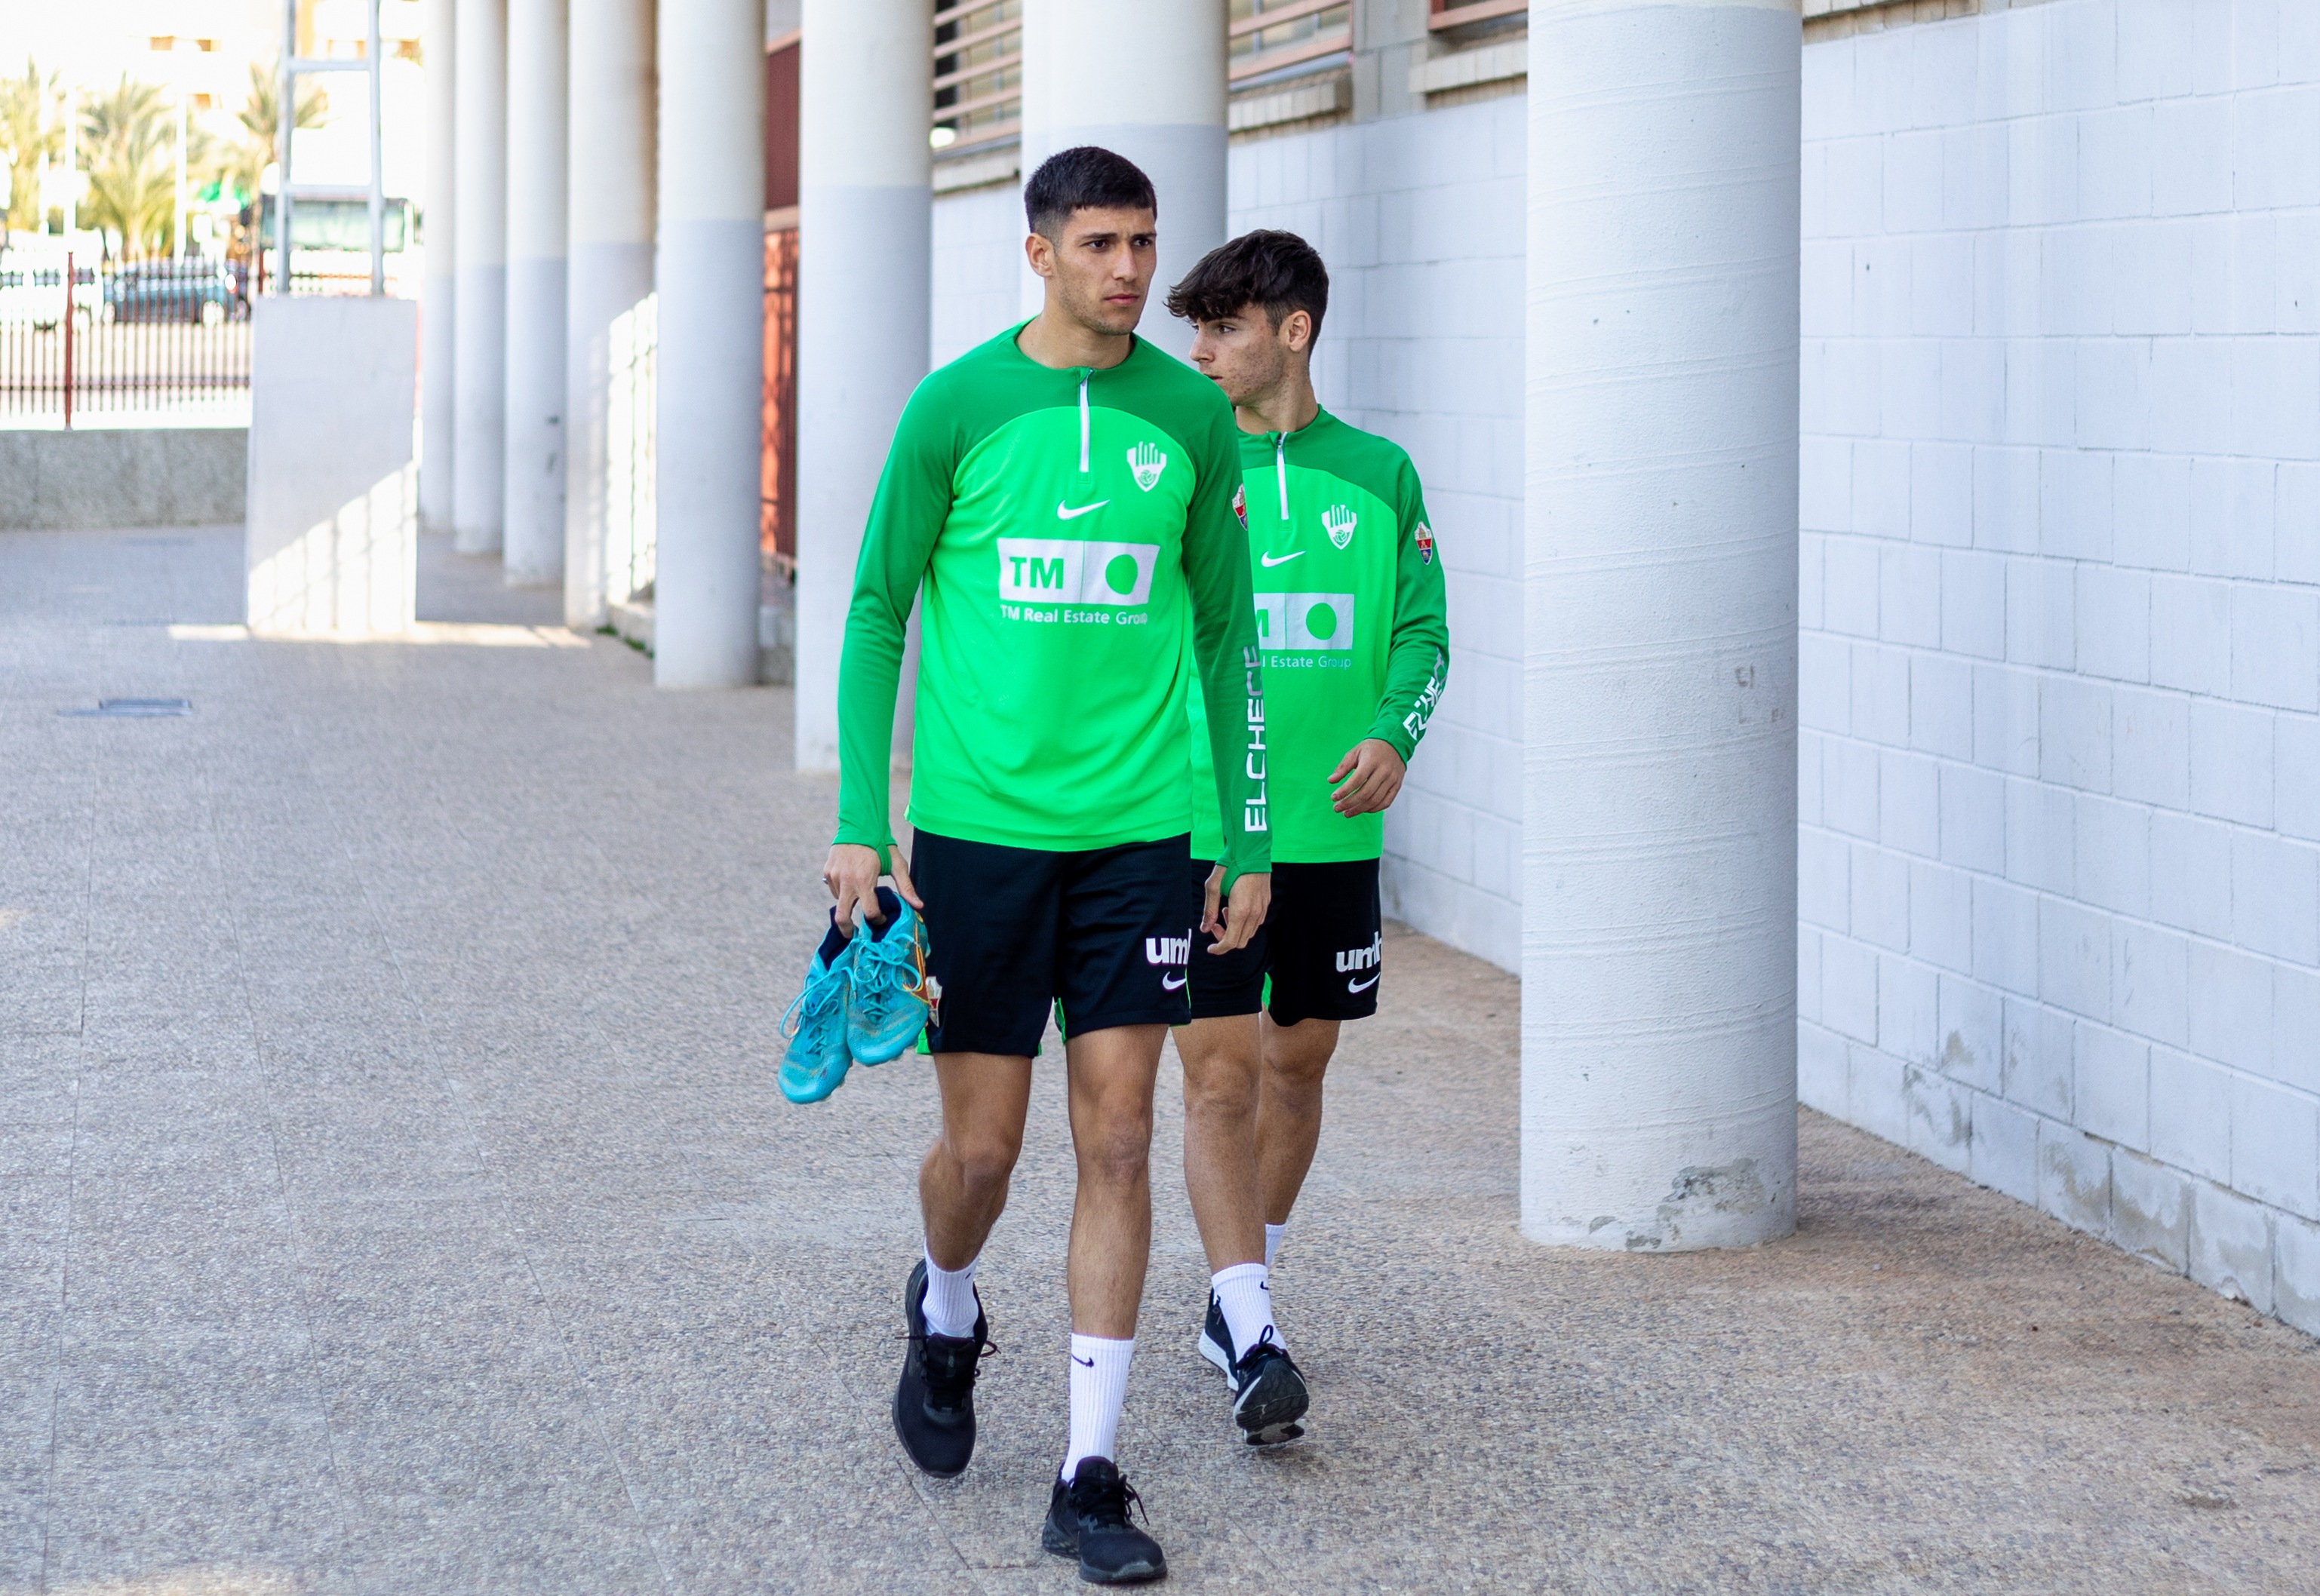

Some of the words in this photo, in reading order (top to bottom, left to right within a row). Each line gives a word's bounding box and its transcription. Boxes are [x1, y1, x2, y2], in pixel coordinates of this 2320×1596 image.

[1009, 556, 1065, 590] TM
[1000, 604, 1020, 621] TM
[1024, 608, 1059, 623] Real
[1063, 609, 1111, 624] Estate
[1271, 655, 1314, 668] Estate
[1318, 655, 1351, 671] Group
[1145, 928, 1192, 965] um
